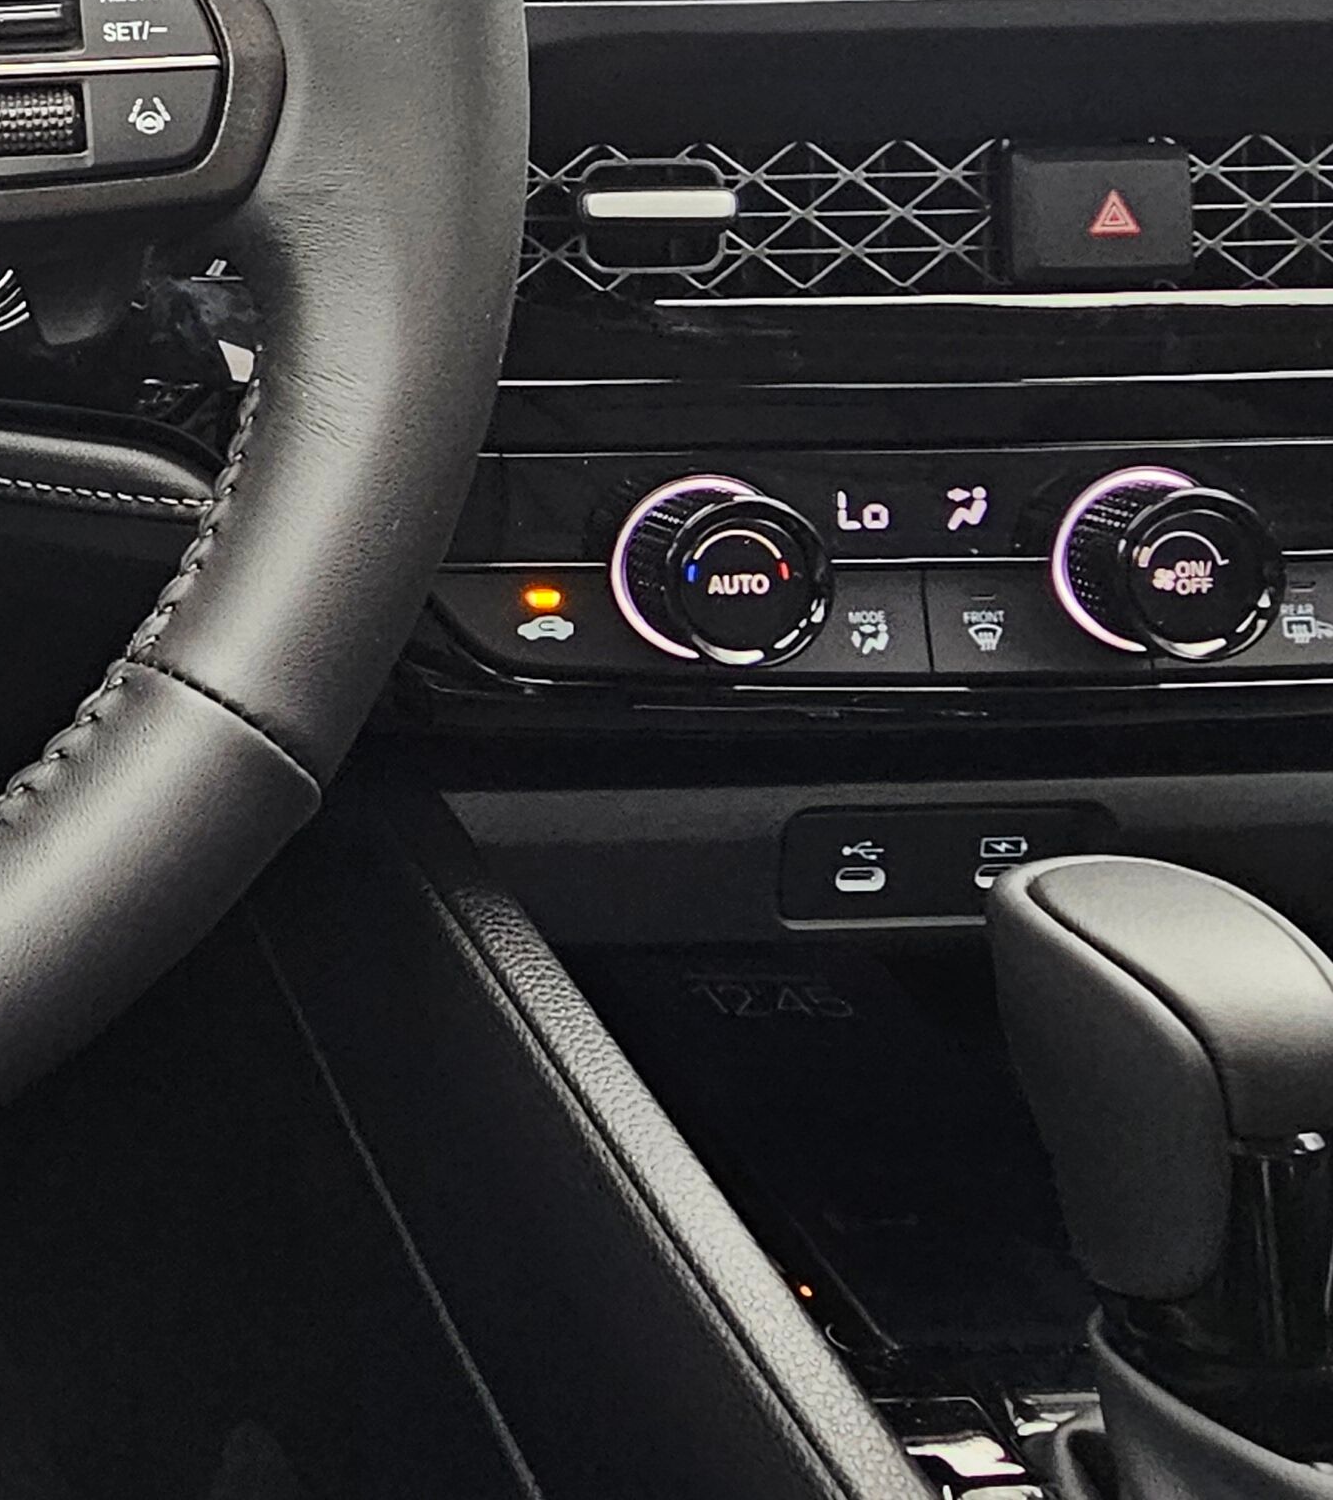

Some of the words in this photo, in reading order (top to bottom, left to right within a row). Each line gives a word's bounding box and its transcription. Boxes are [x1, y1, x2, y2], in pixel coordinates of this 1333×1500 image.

[707, 573, 770, 595] AUTO
[1175, 577, 1213, 595] OFF
[848, 610, 886, 624] MODE
[962, 610, 1005, 623] FRONT
